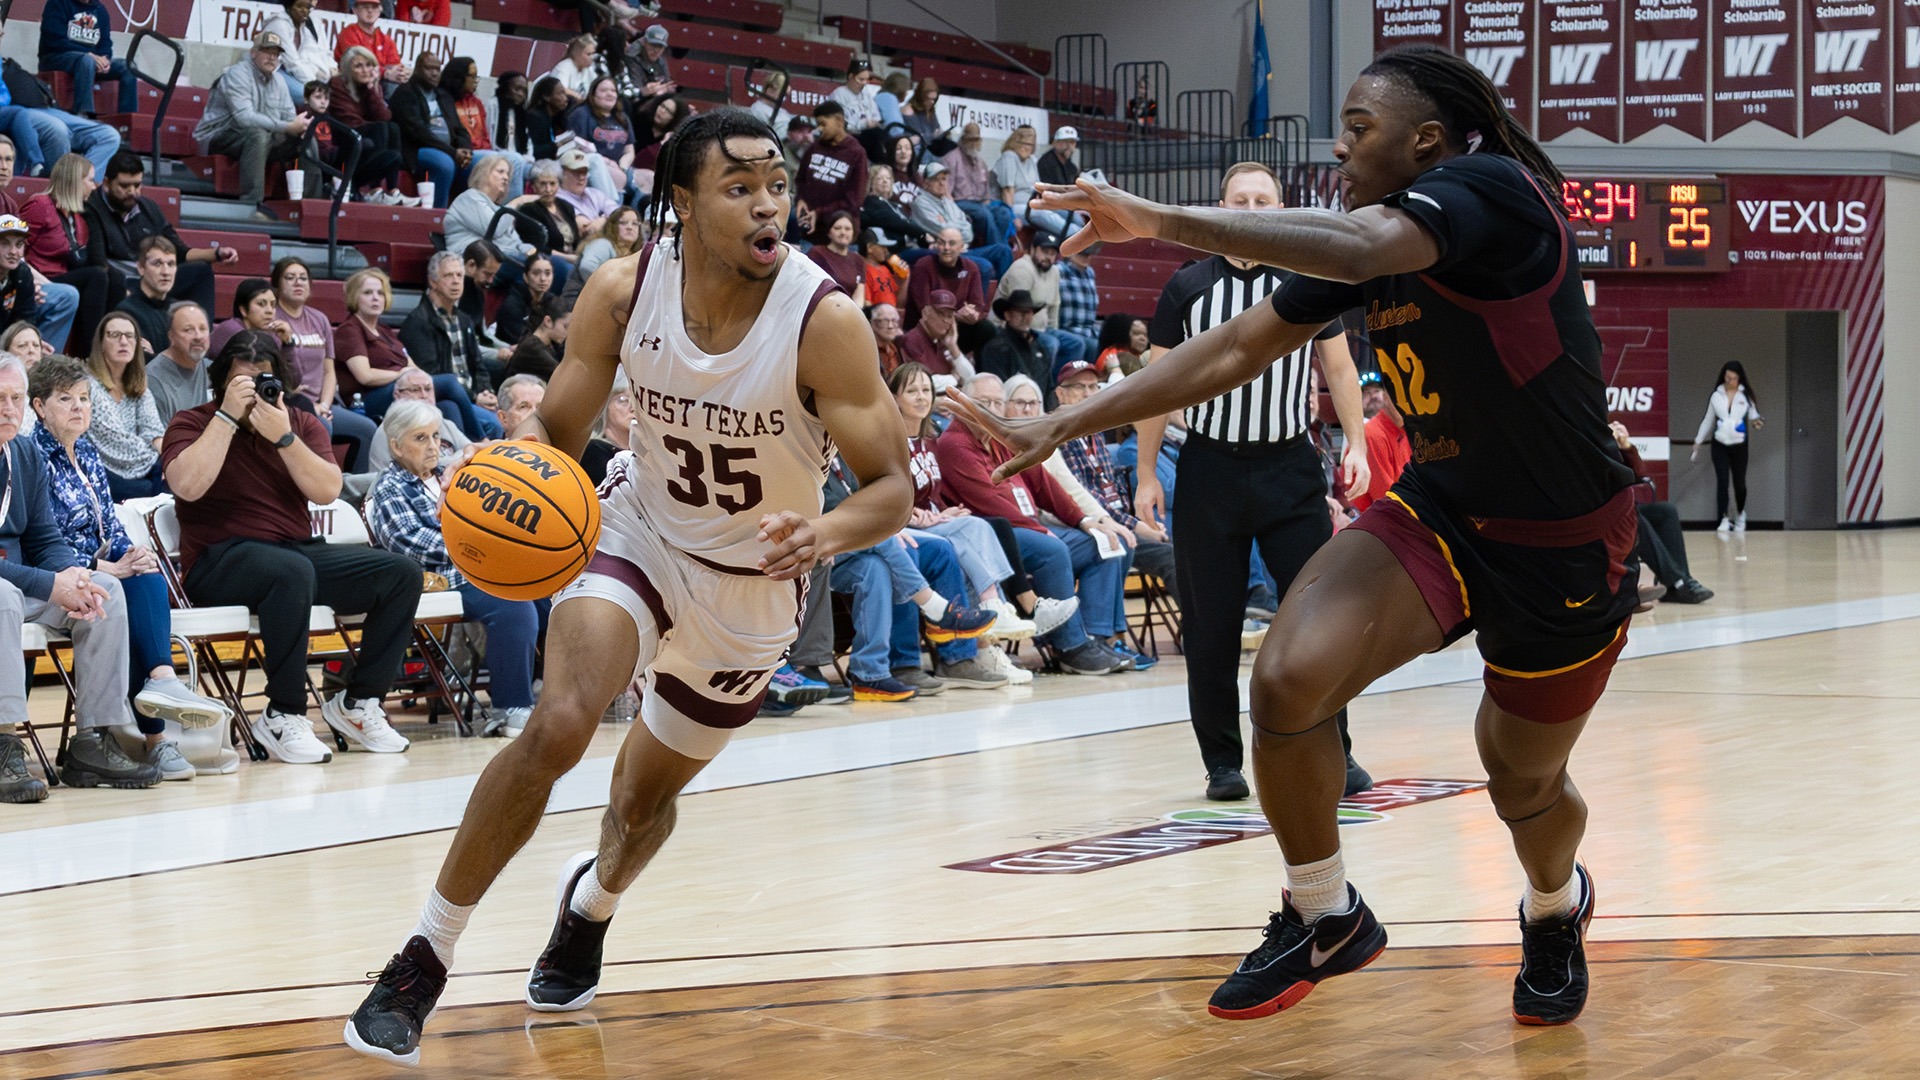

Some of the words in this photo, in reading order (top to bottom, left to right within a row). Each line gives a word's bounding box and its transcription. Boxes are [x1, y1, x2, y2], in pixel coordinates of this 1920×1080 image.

[1384, 8, 1441, 22] Leadership
[1464, 1, 1525, 14] Castleberry
[1556, 3, 1603, 17] Memorial
[1634, 6, 1698, 20] Scholarship
[1724, 8, 1786, 23] Scholarship
[1815, 4, 1876, 18] Scholarship
[1382, 22, 1442, 36] Scholarship
[1470, 14, 1519, 27] Memorial
[1550, 18, 1609, 32] Scholarship
[385, 27, 456, 65] OTION
[1463, 28, 1525, 43] Scholarship
[1635, 39, 1699, 82] WT
[1724, 33, 1789, 78] WT
[1814, 28, 1881, 74] WT
[1549, 43, 1613, 85] WT
[1811, 84, 1841, 96] MEN'S
[1843, 82, 1881, 95] SOCCER
[949, 103, 967, 127] WT
[1834, 100, 1859, 110] 1999
[1671, 185, 1698, 203] MSU
[1668, 207, 1711, 247] 25
[1736, 200, 1867, 233] VEXUS
[1629, 241, 1637, 267] 1
[1744, 250, 1767, 260] 100%
[1824, 250, 1864, 260] Internet
[1376, 343, 1440, 416] 12
[630, 378, 697, 428] WEST
[702, 401, 785, 438] TEXAS
[489, 445, 561, 481] NCAA
[662, 433, 764, 516] 35
[455, 471, 542, 535] Wilson
[708, 669, 770, 696] WT
[990, 825, 1266, 871] UNITED
